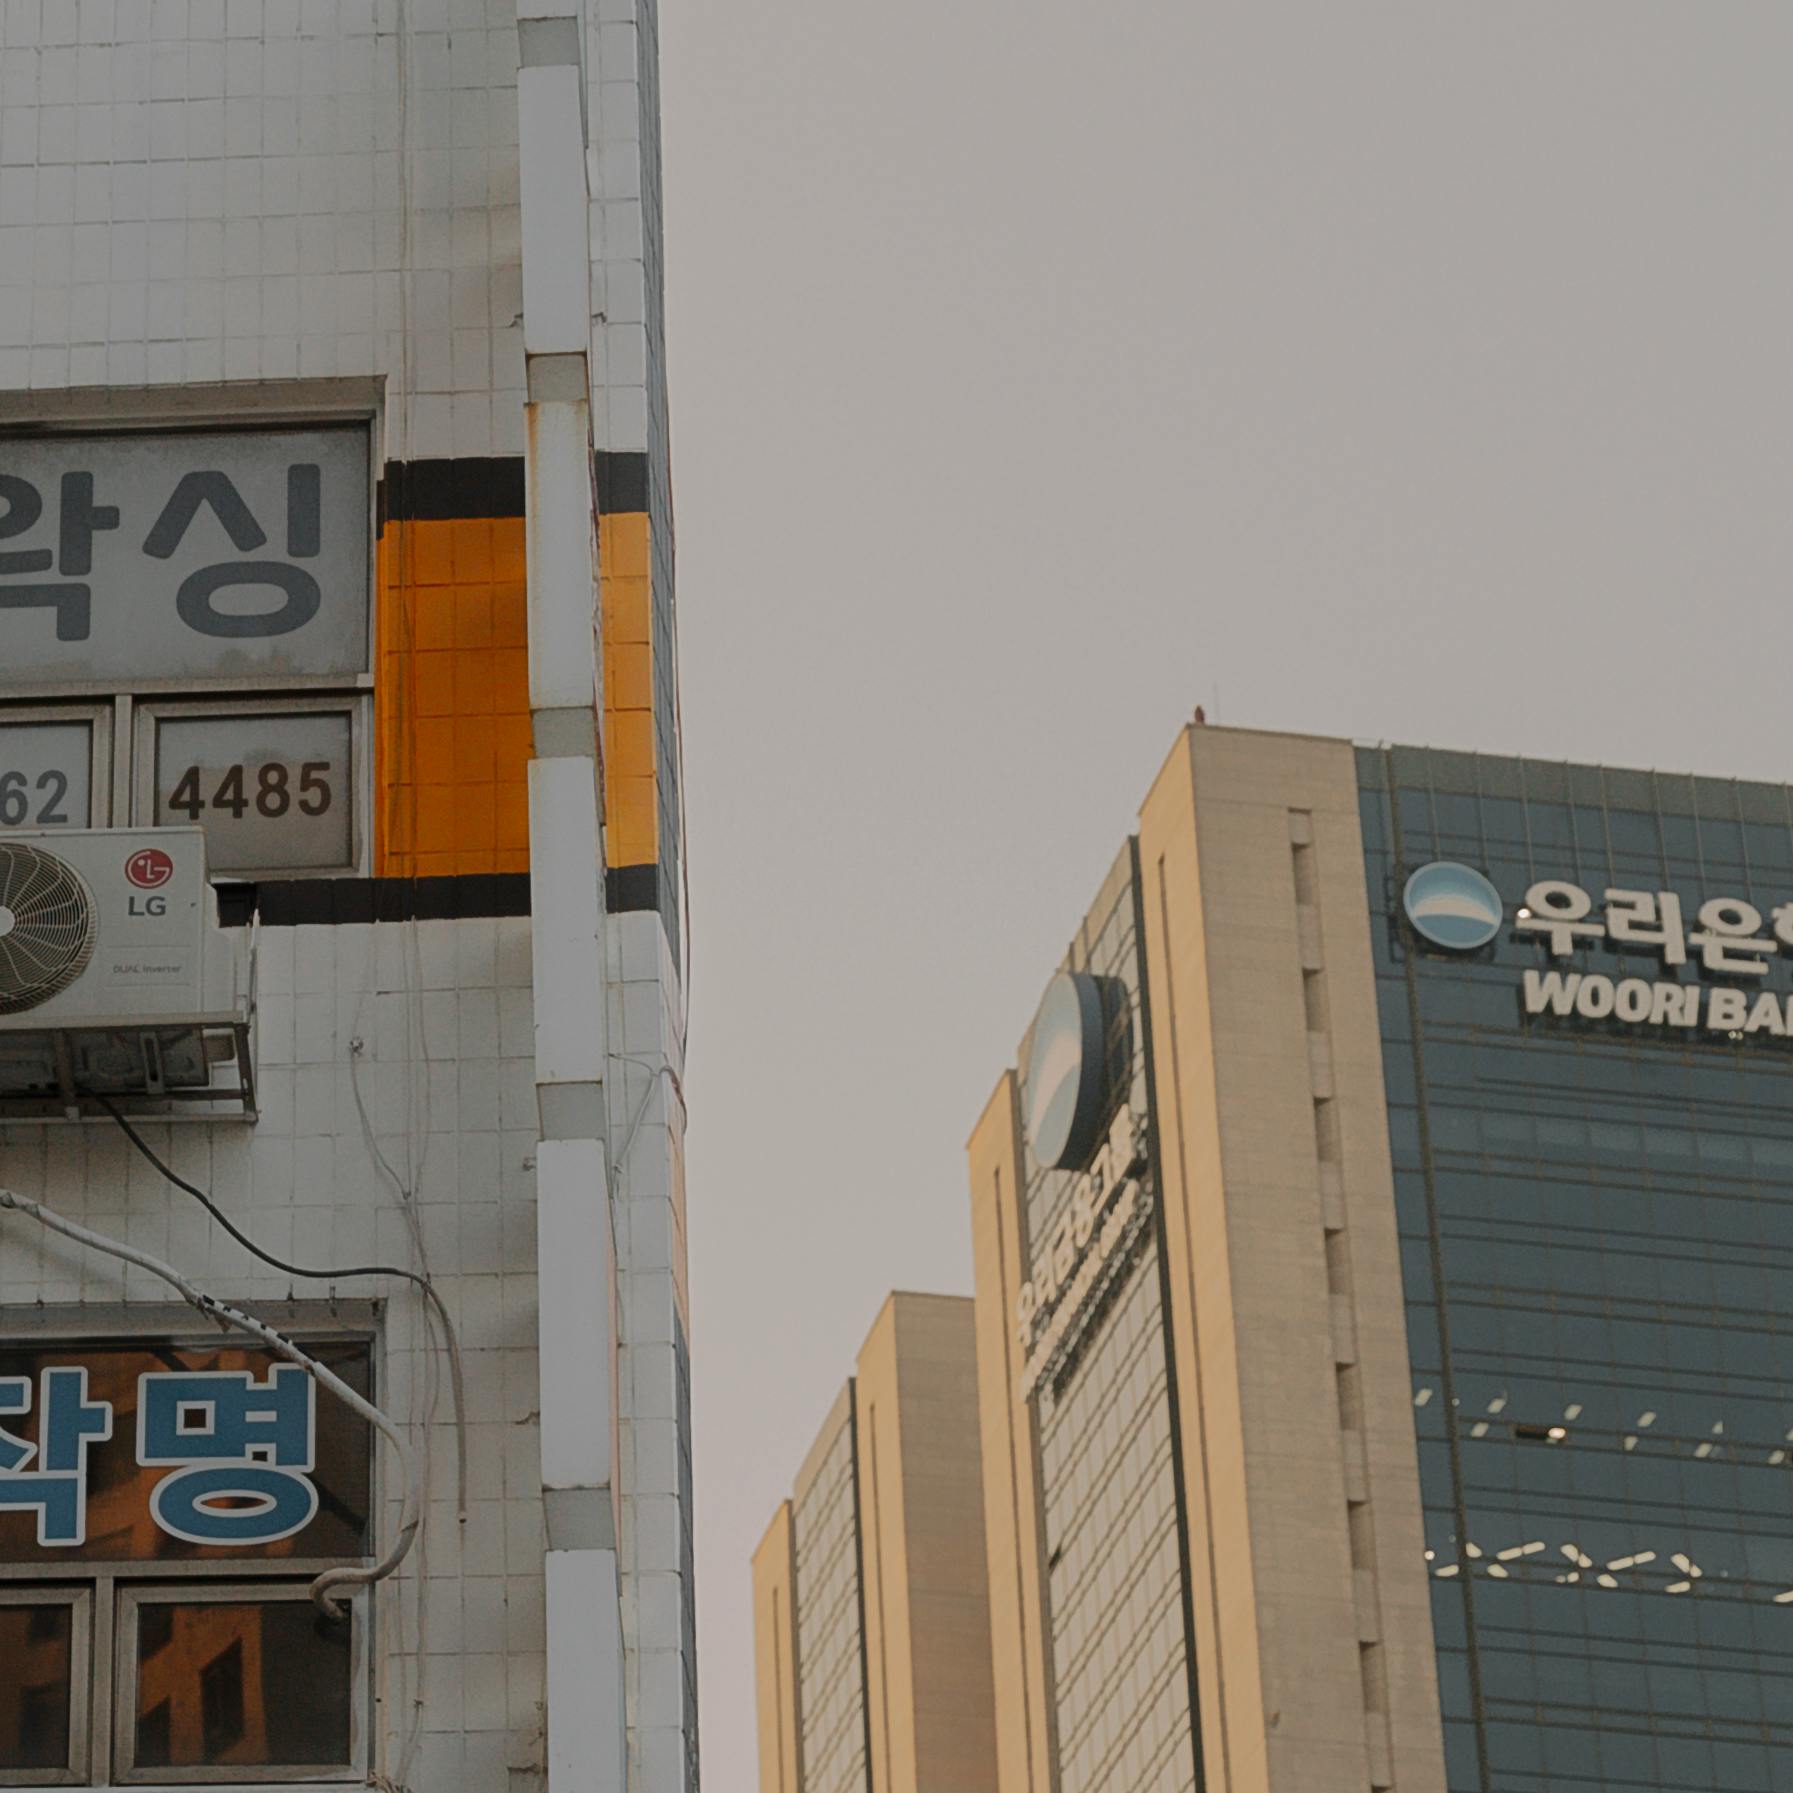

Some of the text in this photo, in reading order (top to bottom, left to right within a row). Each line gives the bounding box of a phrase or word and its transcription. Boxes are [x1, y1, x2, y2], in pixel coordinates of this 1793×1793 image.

[168, 761, 332, 820] 4485
[128, 895, 166, 917] LG
[1515, 880, 1793, 976] 우리은
[1523, 969, 1793, 1037] WOORI BA
